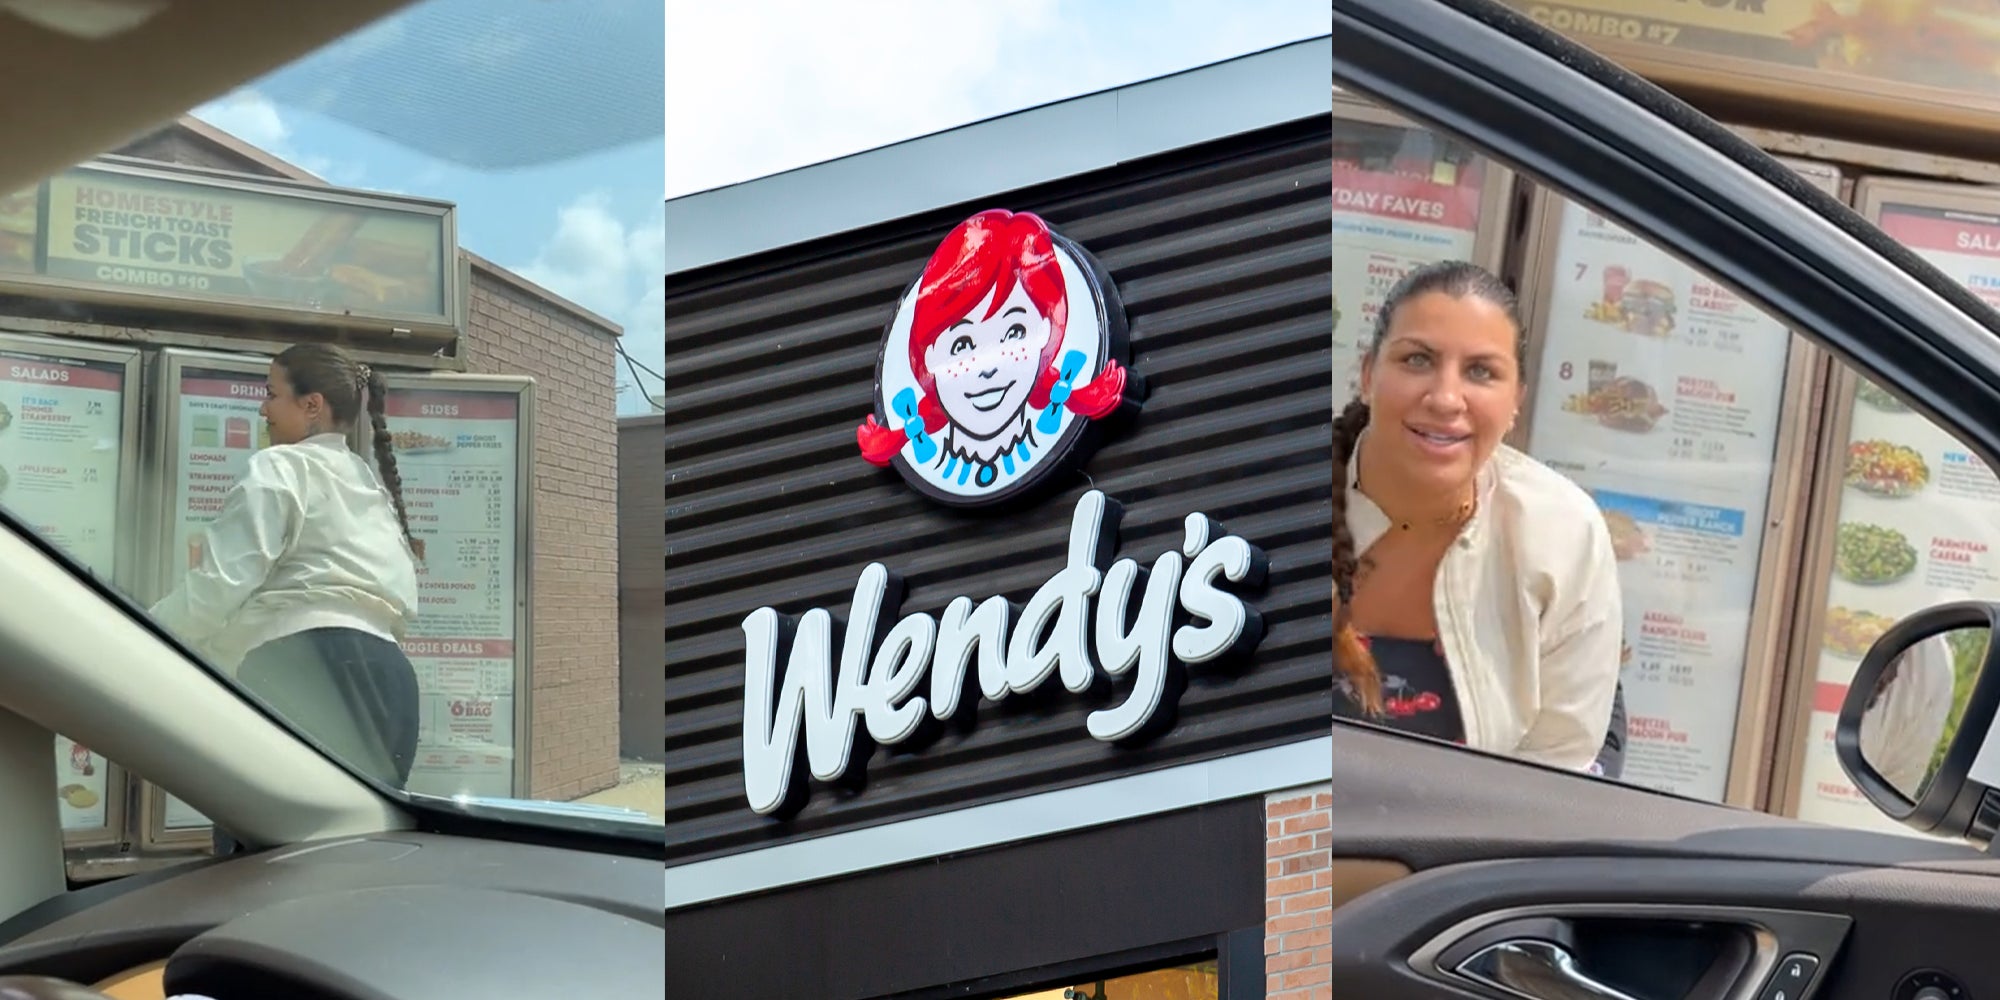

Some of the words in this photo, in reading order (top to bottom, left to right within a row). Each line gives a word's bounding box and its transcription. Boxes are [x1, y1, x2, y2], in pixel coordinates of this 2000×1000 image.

[1527, 7, 1643, 40] COMBO
[1647, 23, 1681, 46] #7
[76, 186, 234, 222] HOMESTYLE
[1382, 195, 1445, 219] FAVES
[74, 206, 165, 233] FRENCH
[166, 215, 232, 239] TOAST
[73, 223, 233, 270] STICKS
[96, 265, 174, 288] COMBO
[178, 274, 209, 291] #10
[1575, 263, 1589, 281] 7
[10, 366, 70, 382] SALADS
[1559, 361, 1573, 381] 8
[21, 412, 72, 423] STRAWBERRY
[421, 404, 459, 416] SIDES
[190, 453, 227, 463] LEMONADE
[1931, 536, 1988, 553] PARMESAN
[1929, 548, 1972, 563] CAESAR
[450, 583, 477, 592] POTATO
[431, 597, 457, 606] POTATO
[442, 643, 484, 655] DEALS
[742, 490, 1254, 816] Wendy's
[465, 707, 493, 718] BAG
